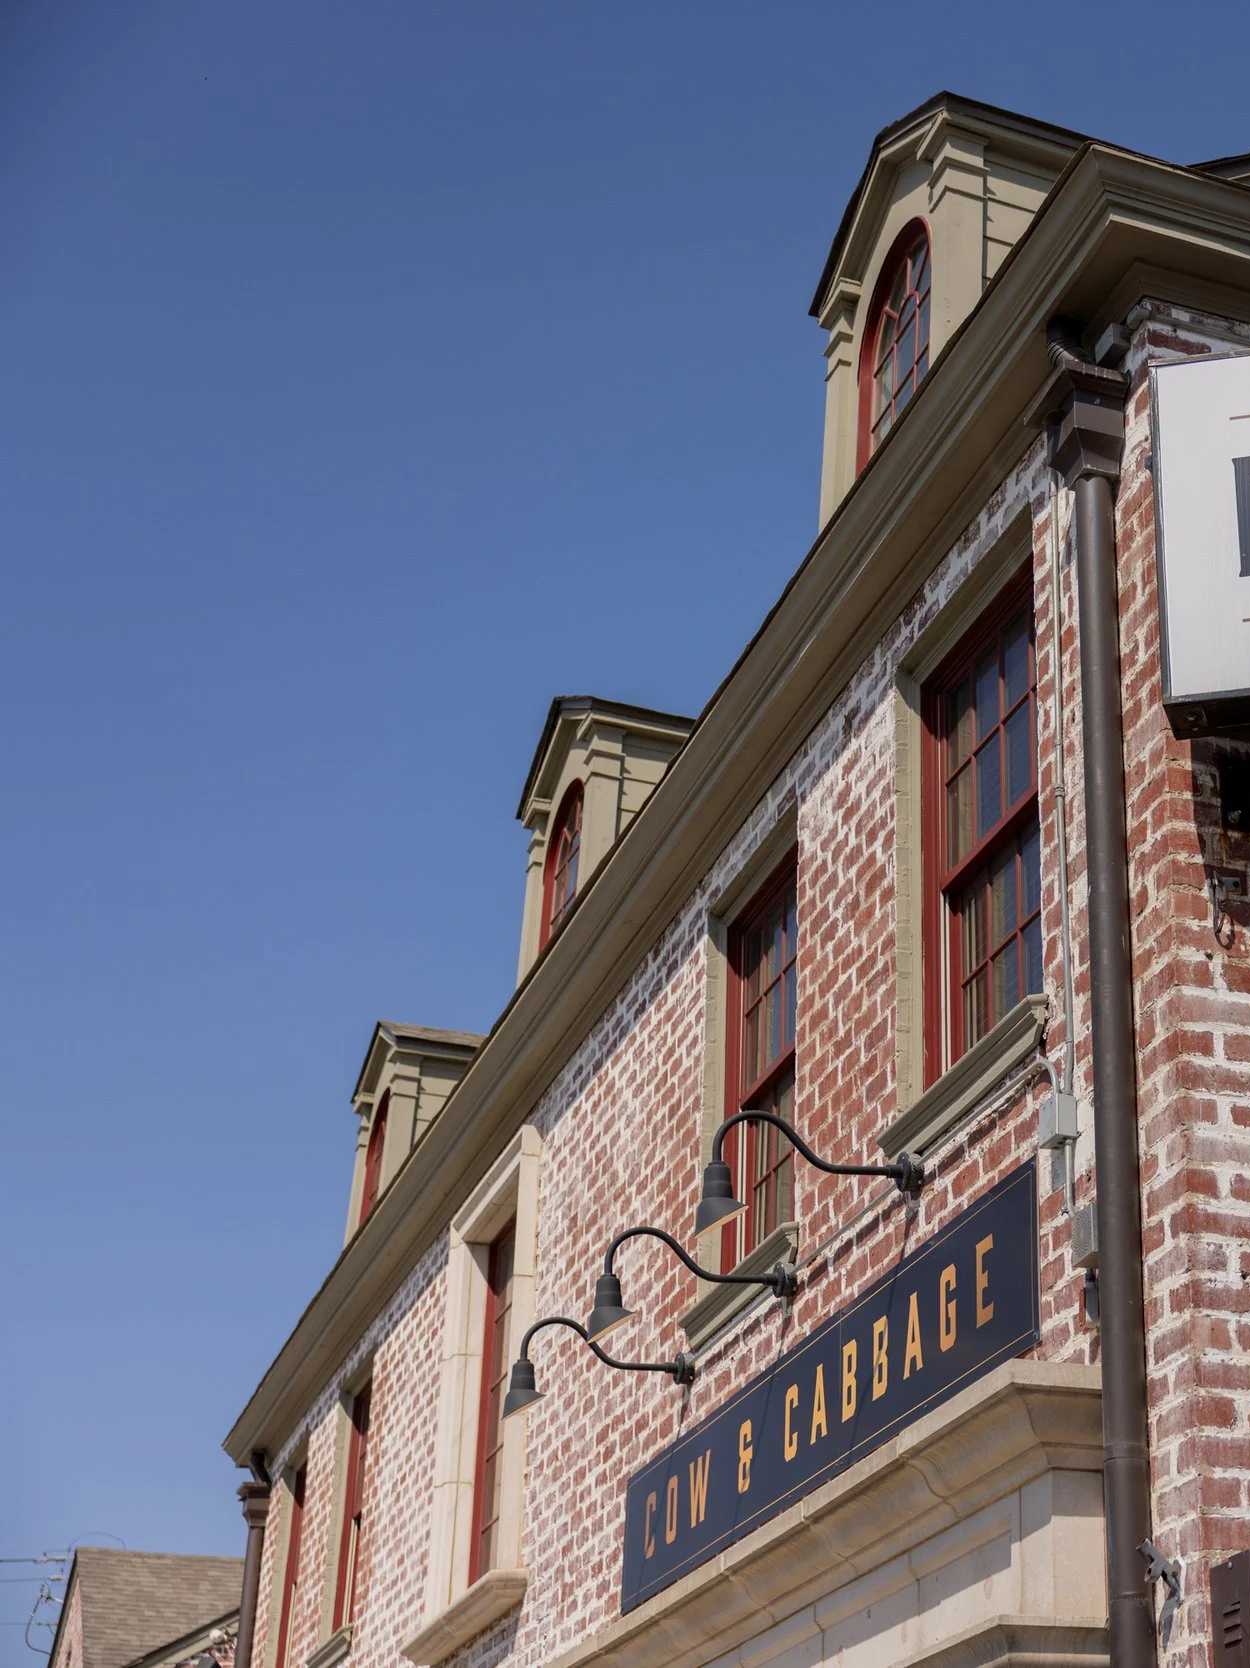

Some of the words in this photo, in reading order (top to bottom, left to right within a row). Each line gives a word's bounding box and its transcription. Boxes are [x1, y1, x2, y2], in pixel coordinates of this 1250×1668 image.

[644, 1449, 711, 1559] COW
[737, 1419, 753, 1494] &
[783, 1233, 995, 1462] CABBAGE
